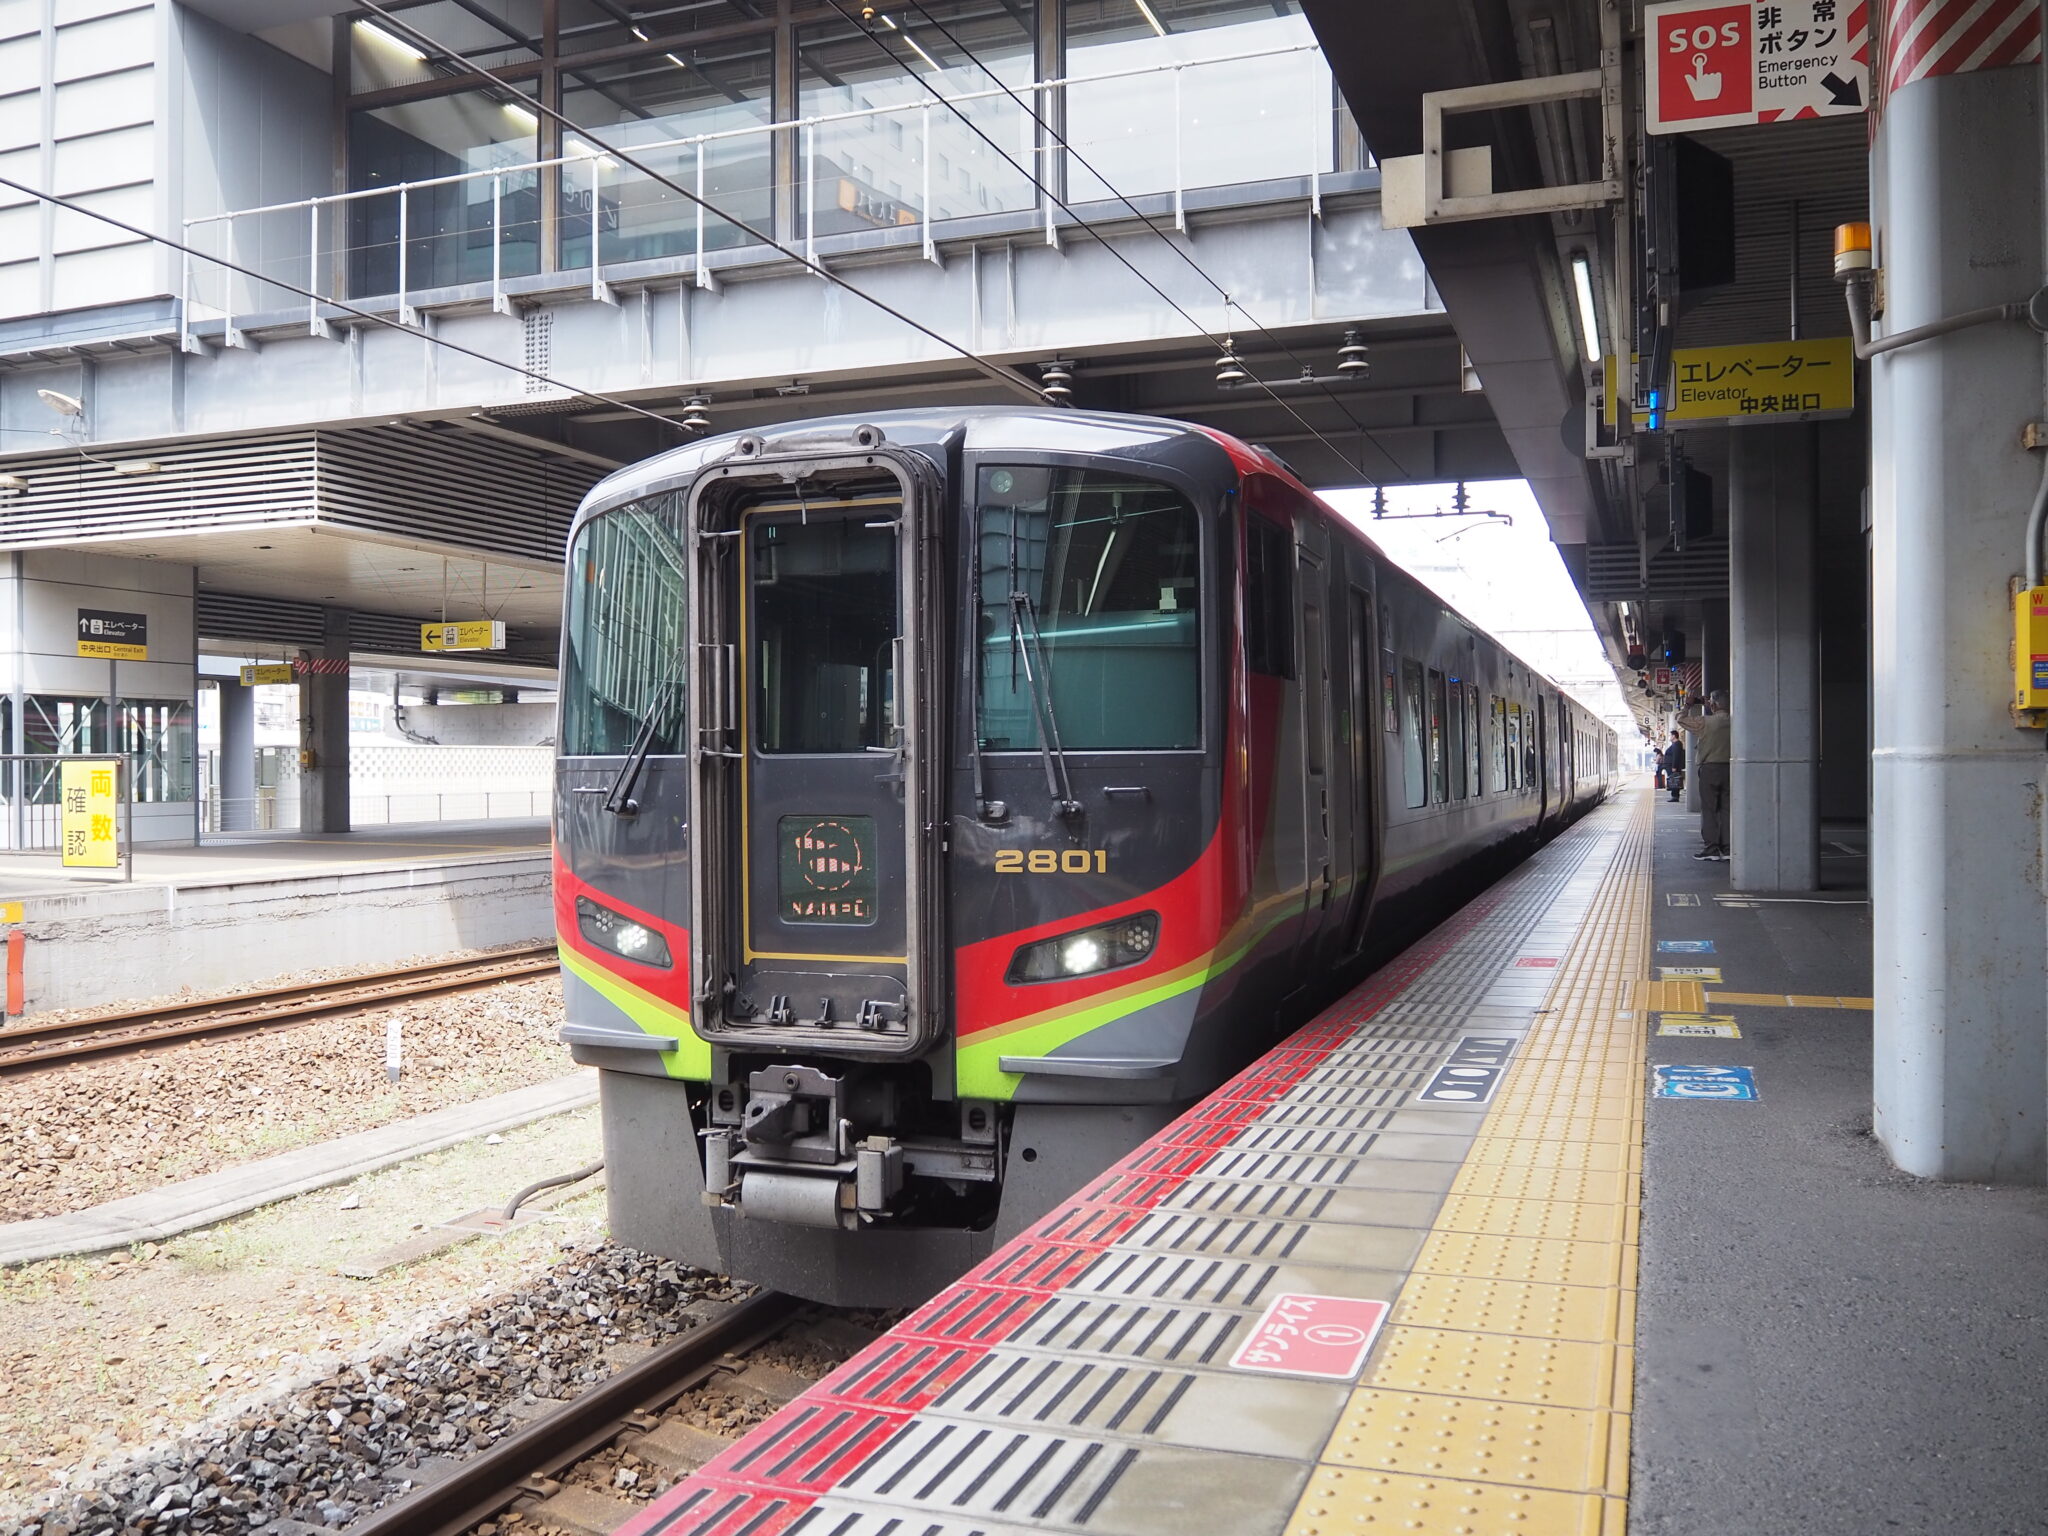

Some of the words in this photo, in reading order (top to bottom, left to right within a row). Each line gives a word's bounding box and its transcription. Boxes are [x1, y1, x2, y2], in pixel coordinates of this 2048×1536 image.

[1758, 0, 1836, 30] 非常
[1669, 22, 1740, 53] SOS
[1759, 28, 1837, 54] ボタン
[1758, 54, 1838, 74] Emergency
[1758, 73, 1807, 90] Button
[1681, 355, 1831, 384] エレベーター
[1681, 387, 1748, 403] Elevator
[1740, 393, 1821, 414] 中央出口
[103, 620, 145, 631] エレベーター
[460, 627, 488, 636] エレベーター
[81, 644, 112, 654] 中央出口
[90, 769, 112, 842] 両数
[67, 787, 87, 856] 確認
[995, 849, 1106, 873] 2801
